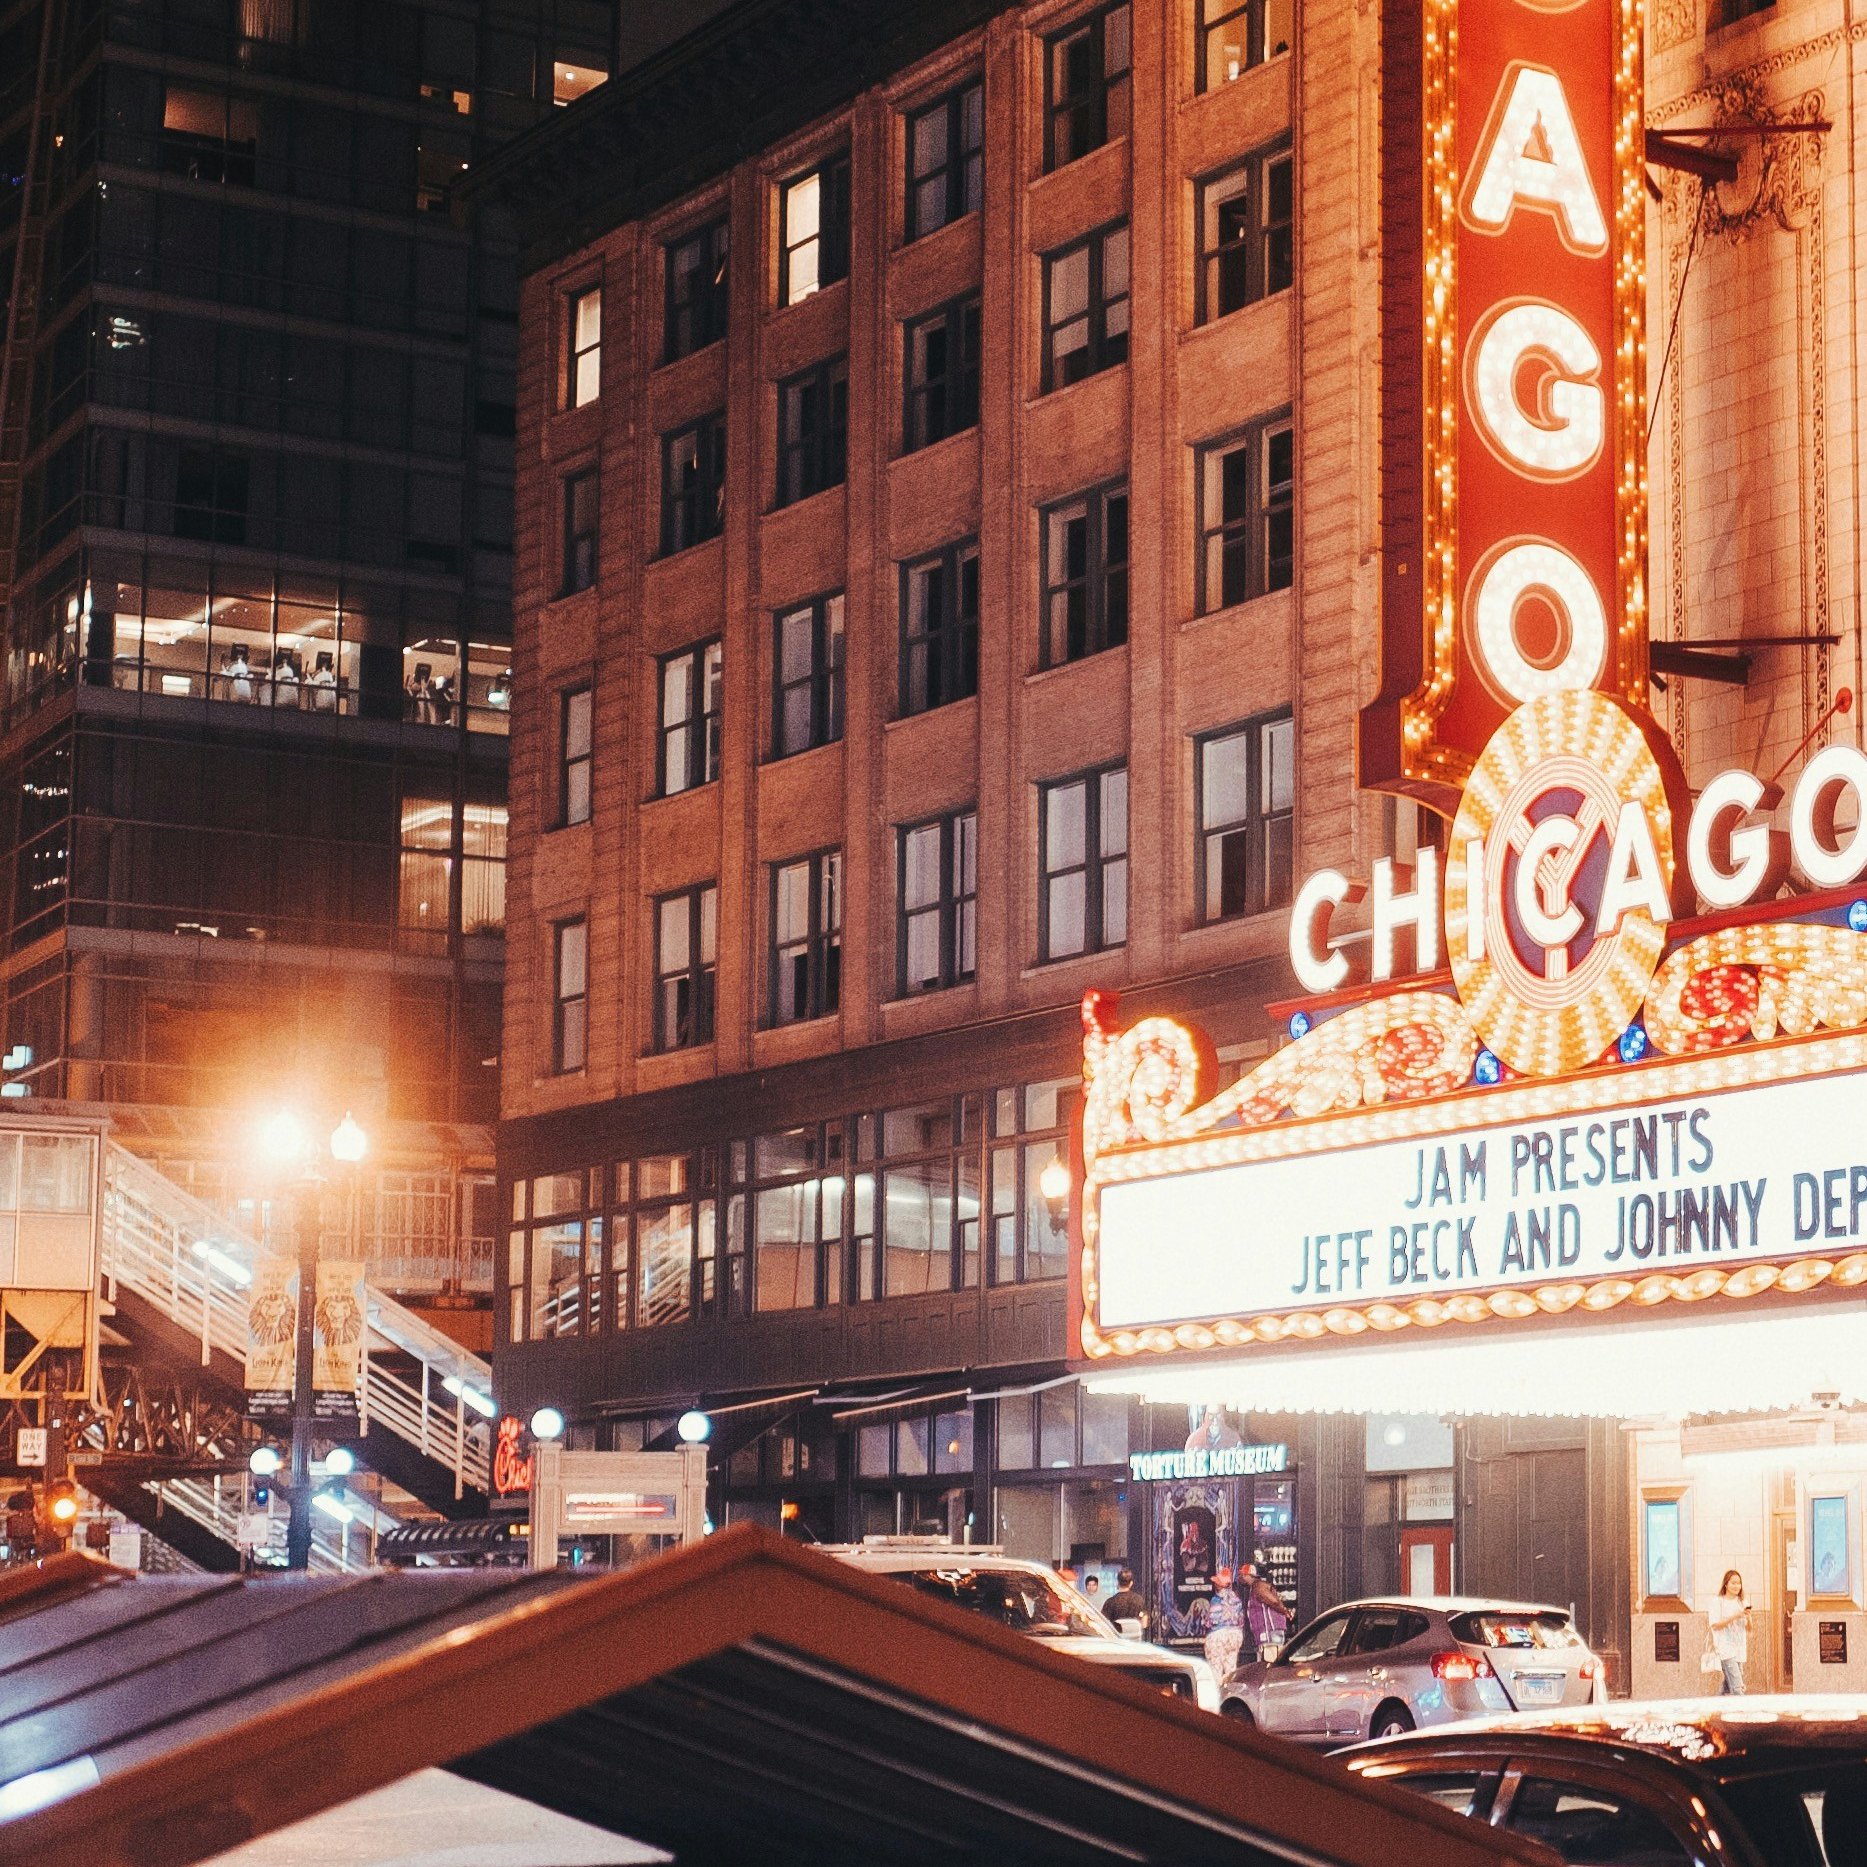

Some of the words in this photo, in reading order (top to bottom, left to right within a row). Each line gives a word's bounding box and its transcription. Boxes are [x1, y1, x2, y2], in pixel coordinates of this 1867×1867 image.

[1404, 1140, 1487, 1209] JAM
[1511, 1107, 1715, 1198] PRESENTS
[1291, 1229, 1373, 1294] JEFF
[1388, 1216, 1479, 1286] BECK
[1499, 1203, 1581, 1275] AND
[1603, 1177, 1767, 1262] JOHNNY
[22, 1433, 42, 1441] ONE
[22, 1442, 42, 1451] WAY
[1130, 1451, 1208, 1481] TORTURE
[1209, 1445, 1285, 1476] MUSEUM
